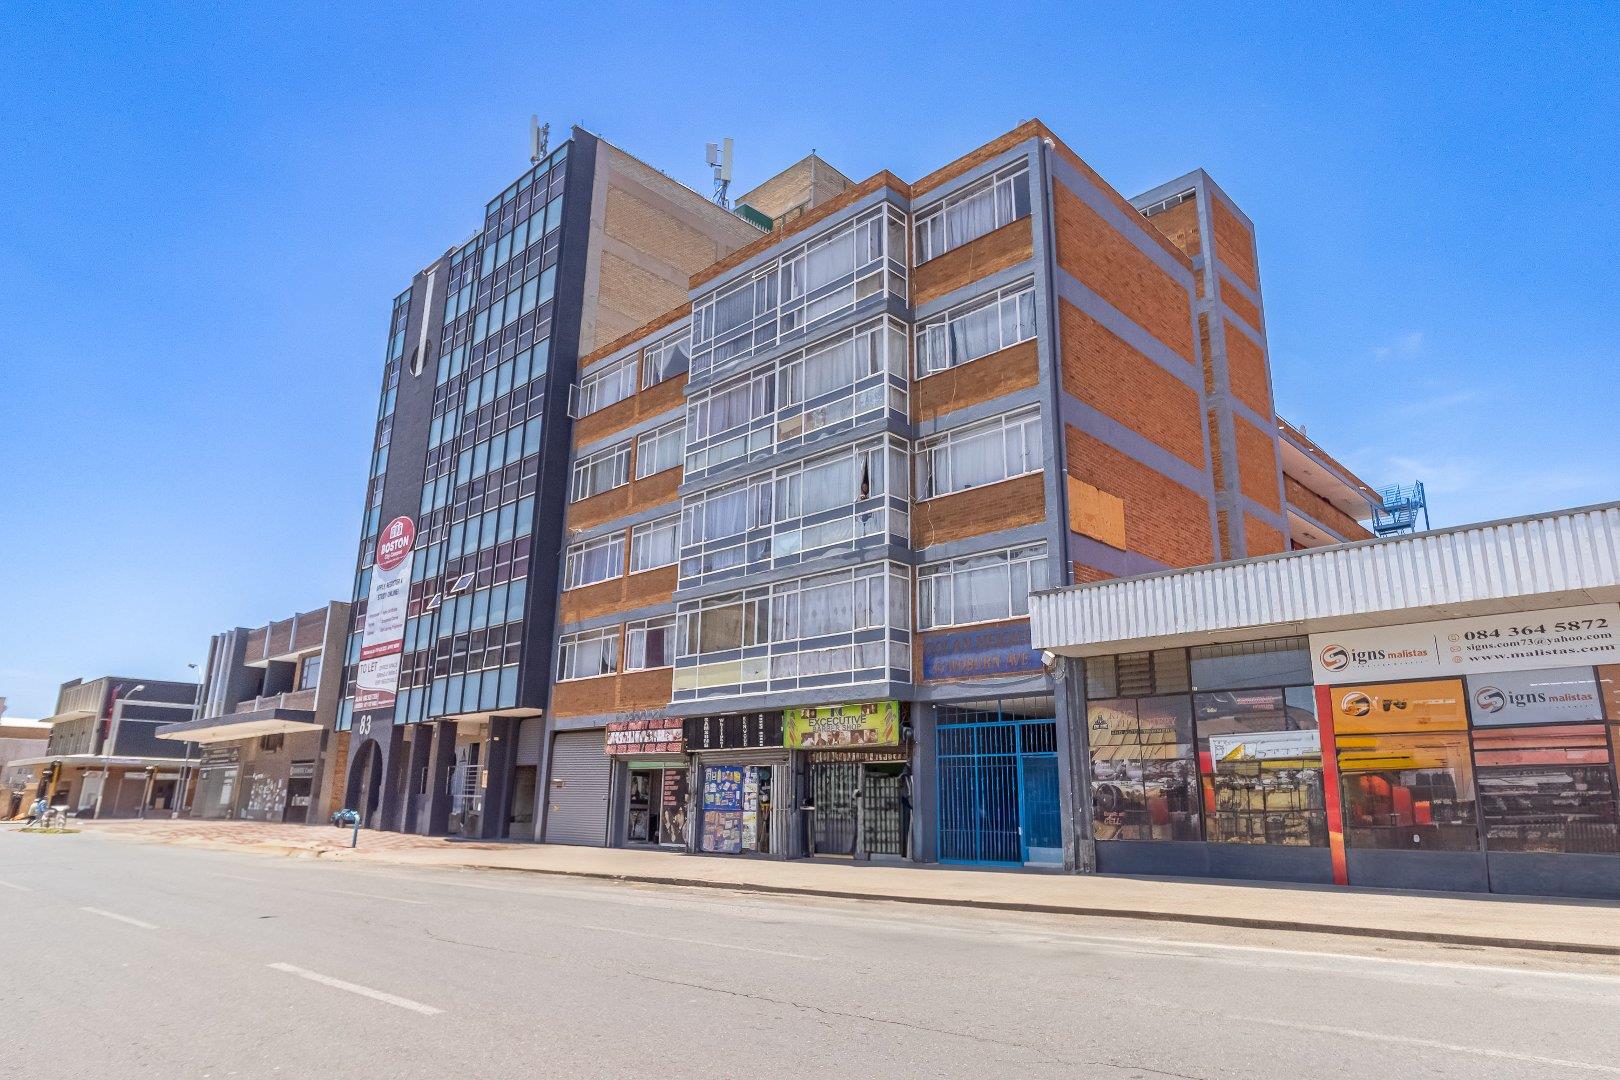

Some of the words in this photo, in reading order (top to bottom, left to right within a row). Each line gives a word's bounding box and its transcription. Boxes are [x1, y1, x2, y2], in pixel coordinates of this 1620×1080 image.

[381, 535, 409, 555] BOSTON
[1464, 628, 1501, 641] 084
[1508, 624, 1546, 637] 364
[1554, 618, 1609, 633] 5872
[1466, 632, 1613, 651] signs.com73@yahoo.com
[1387, 649, 1428, 659] malistas
[1469, 644, 1616, 662] www.malistas.com
[360, 664, 367, 675] TO
[368, 662, 378, 673] LET
[1548, 692, 1593, 703] malistas
[359, 714, 372, 735] 83
[809, 714, 867, 727] EXCECUTIVE
[813, 724, 840, 733] BARBER
[842, 723, 862, 732] SHOP
